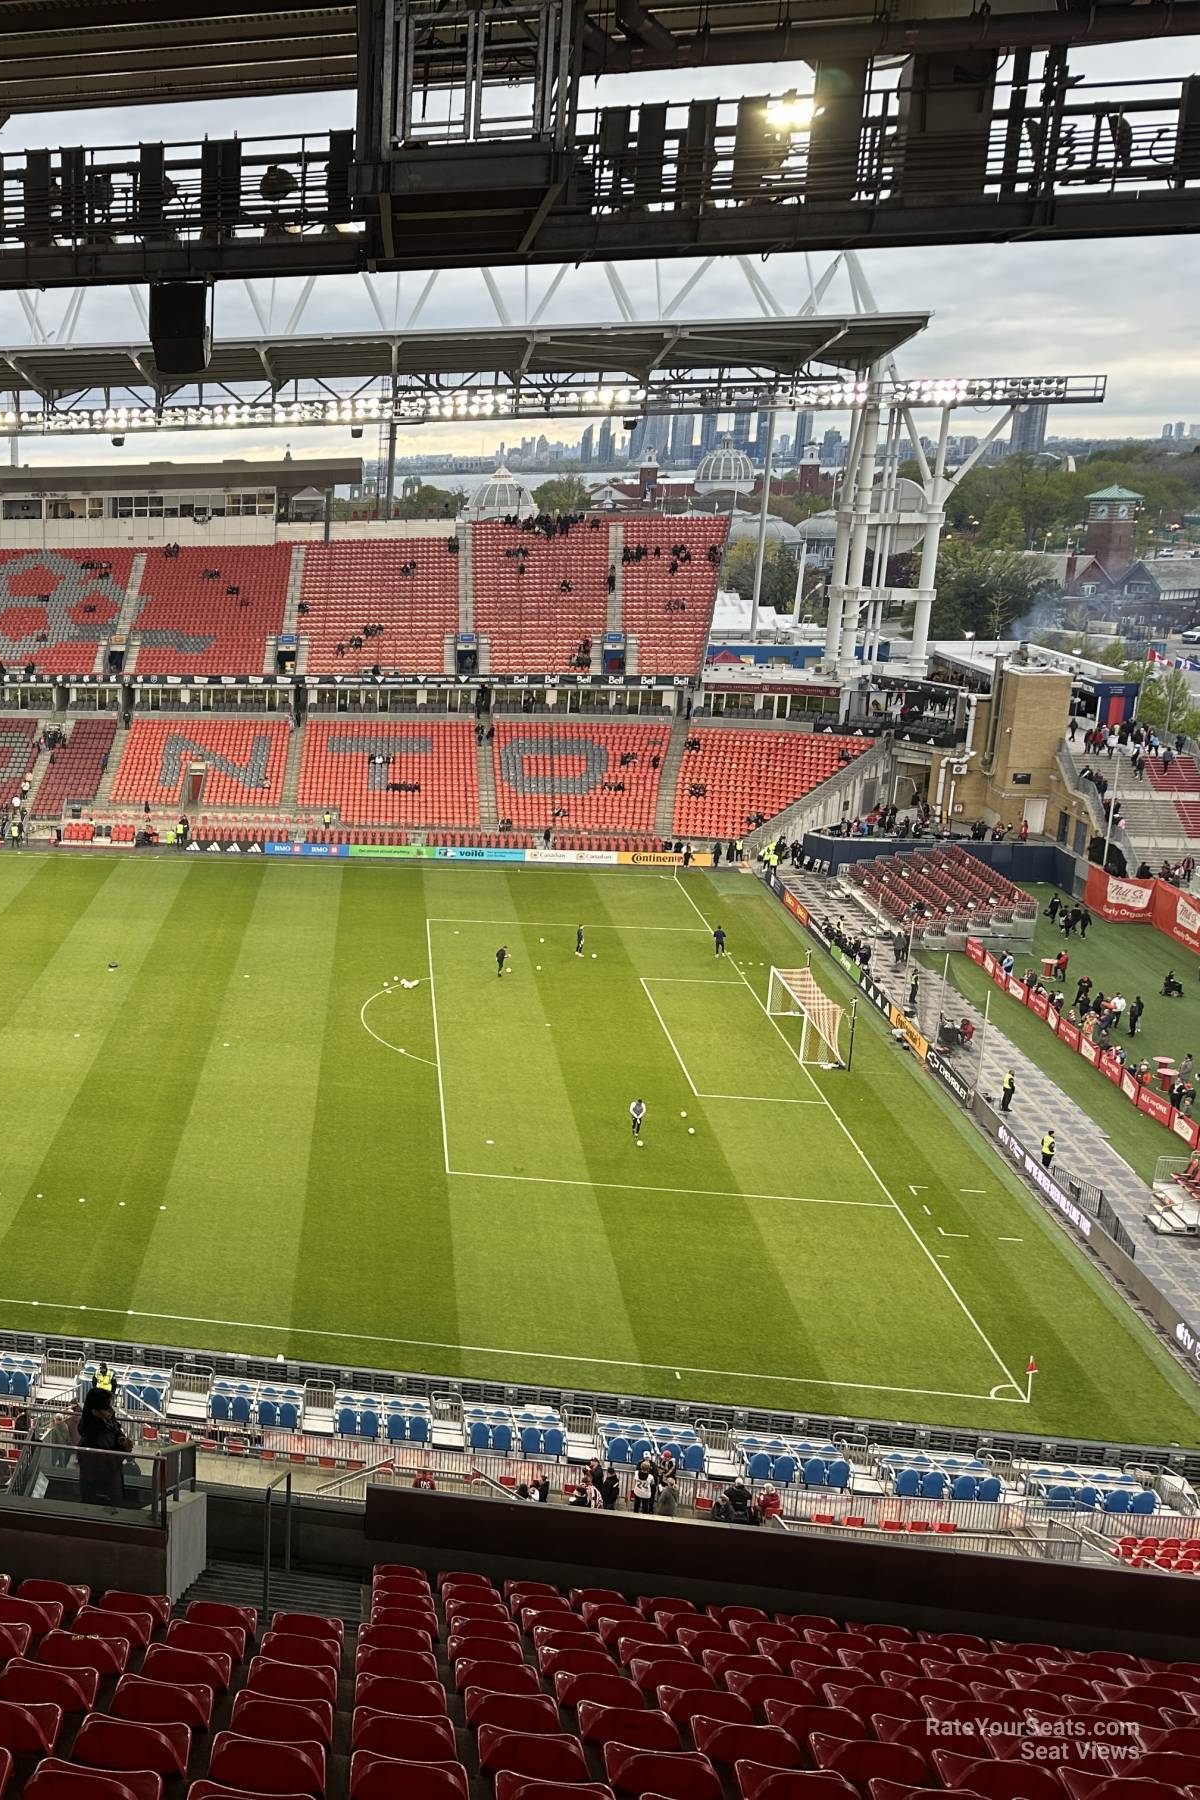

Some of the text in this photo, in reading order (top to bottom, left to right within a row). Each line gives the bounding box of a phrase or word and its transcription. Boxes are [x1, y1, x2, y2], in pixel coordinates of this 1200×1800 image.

[514, 675, 528, 684] Bell
[545, 675, 559, 684] Bell
[577, 675, 591, 684] Bell
[609, 676, 623, 684] Bell
[641, 676, 656, 685] Bell
[673, 676, 689, 685] Bell
[939, 1064, 968, 1100] CHEVROLET
[1141, 1093, 1150, 1104] ALL
[1156, 1103, 1168, 1115] ONE
[1183, 1328, 1195, 1350] tv
